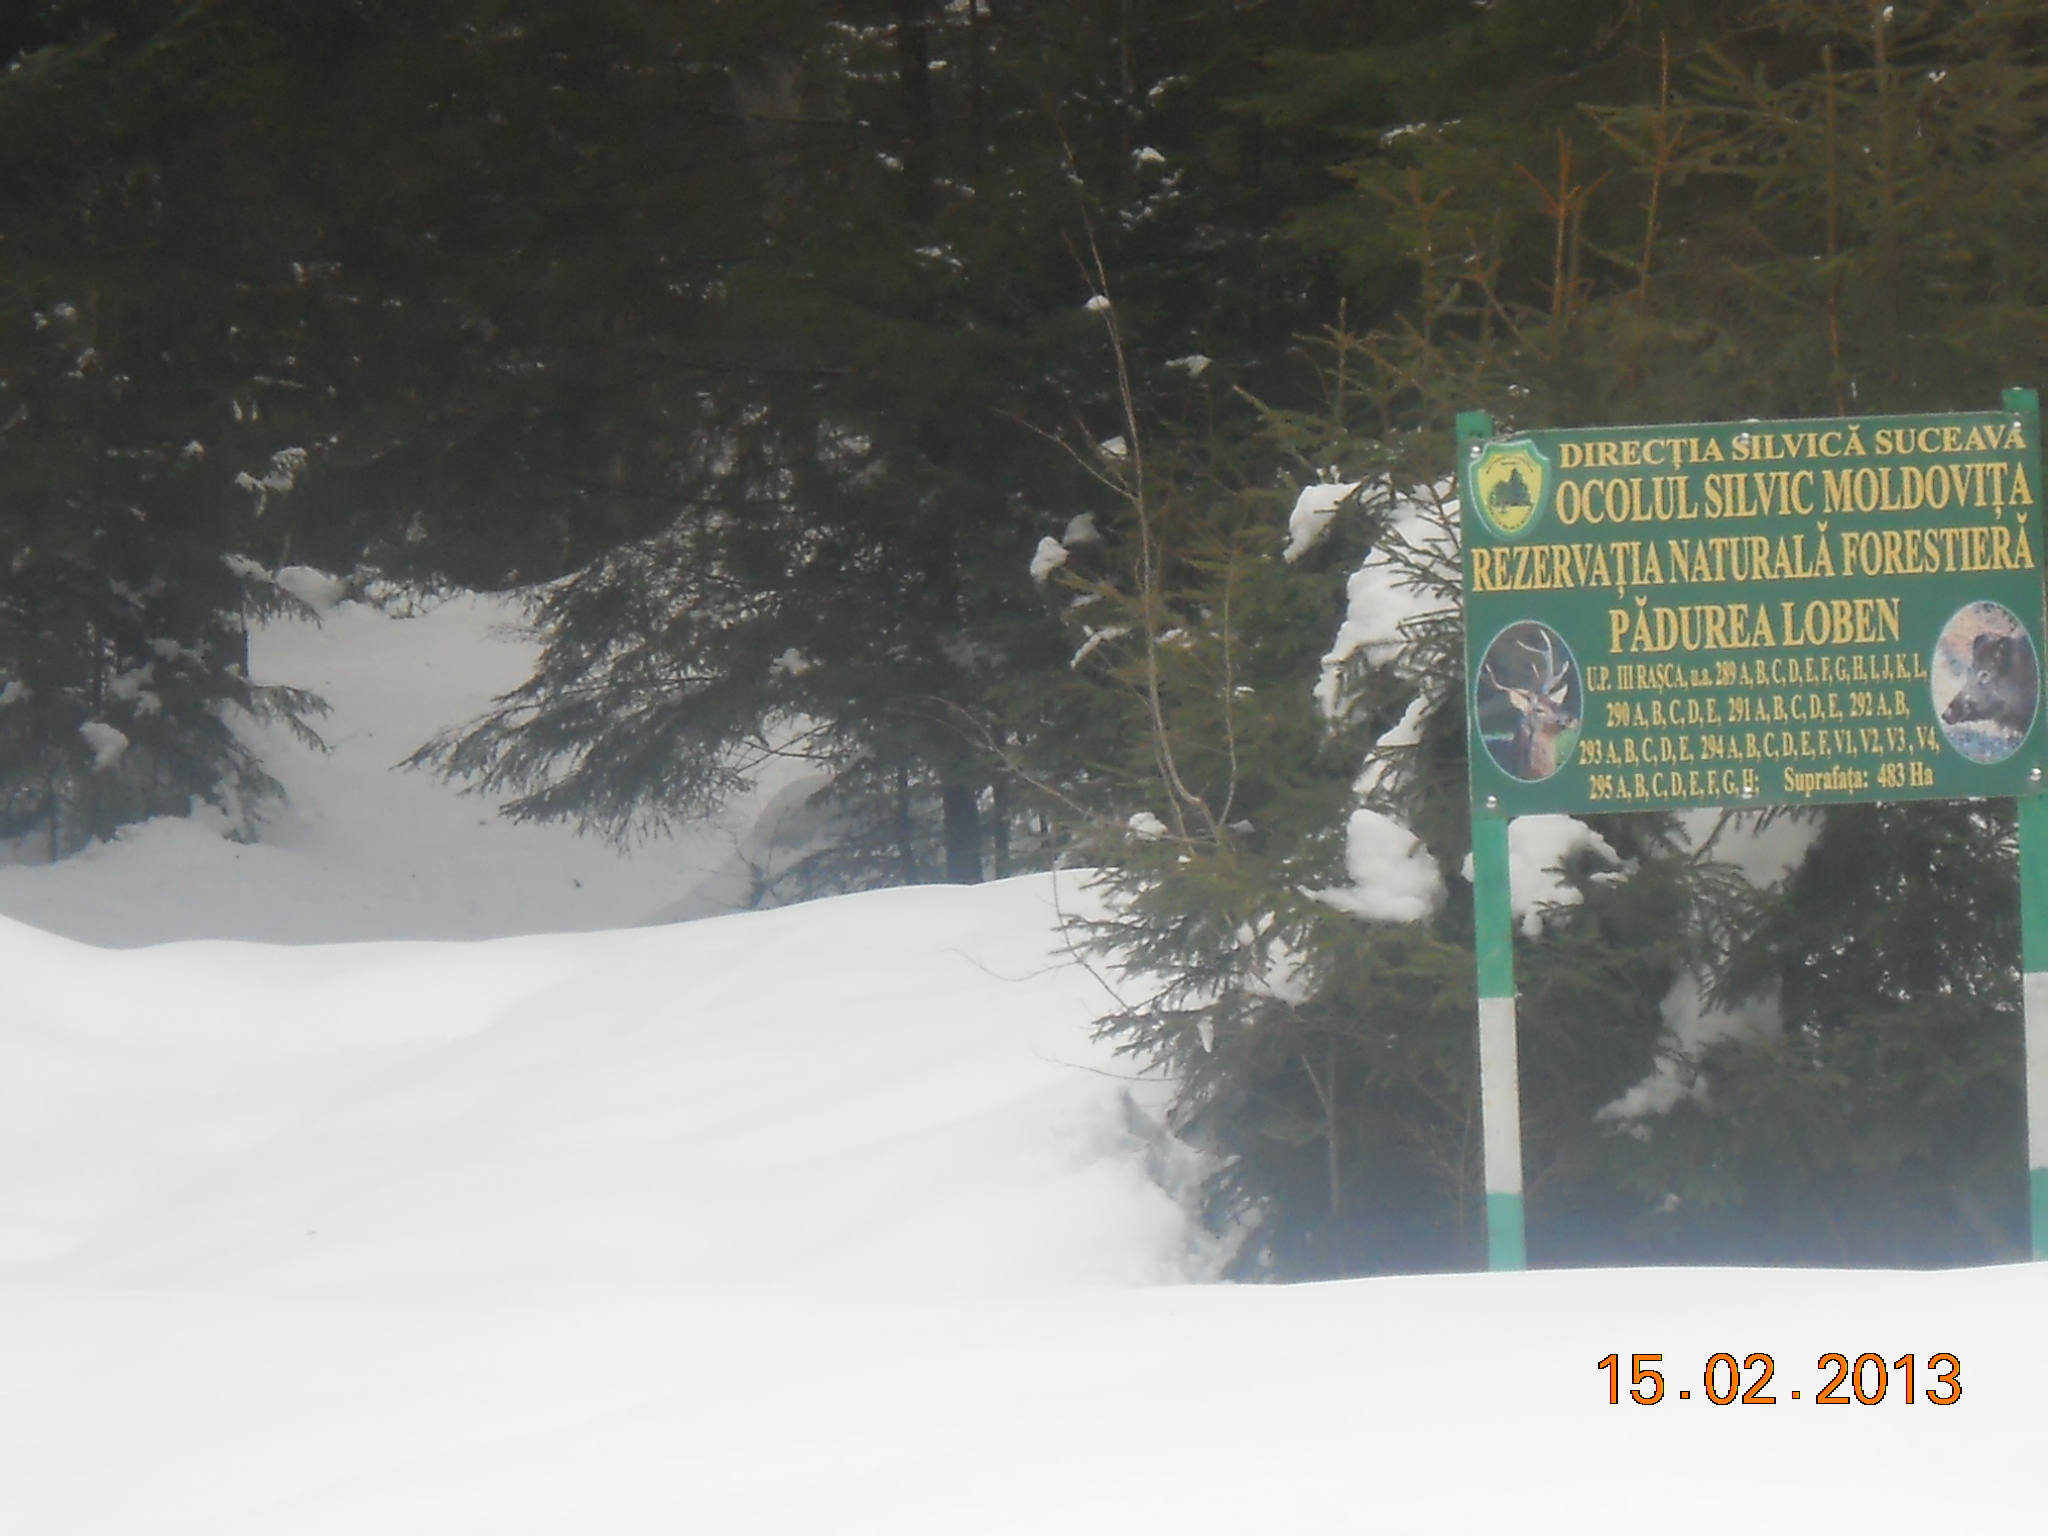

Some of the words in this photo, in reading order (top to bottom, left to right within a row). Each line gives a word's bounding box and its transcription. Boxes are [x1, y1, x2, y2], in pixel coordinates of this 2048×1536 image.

[1559, 437, 1723, 471] DIRECȚIA
[1731, 424, 1866, 462] SILVICĂ
[1555, 475, 1701, 525] OCOLUL
[1704, 468, 1814, 519] SILVIC
[1822, 461, 2034, 520] MOLDOVIȚA
[1471, 539, 1663, 599] REZERVAȚIA
[1667, 523, 1835, 586] NATURALĂ
[1841, 512, 2035, 577] FORESTIERĂ
[1608, 594, 1781, 653] PĂDUREA
[1782, 597, 1901, 649] LOBEN
[1617, 665, 1634, 690] III
[1716, 661, 1736, 686] 289
[1607, 701, 1630, 727] 290
[1728, 697, 1750, 722] 291
[1850, 692, 1872, 717] 292
[1579, 740, 1602, 765] 293
[1701, 735, 1723, 760] 294
[1590, 775, 1612, 800] 295
[1877, 763, 1905, 788] 483
[1910, 762, 1933, 786] Ha
